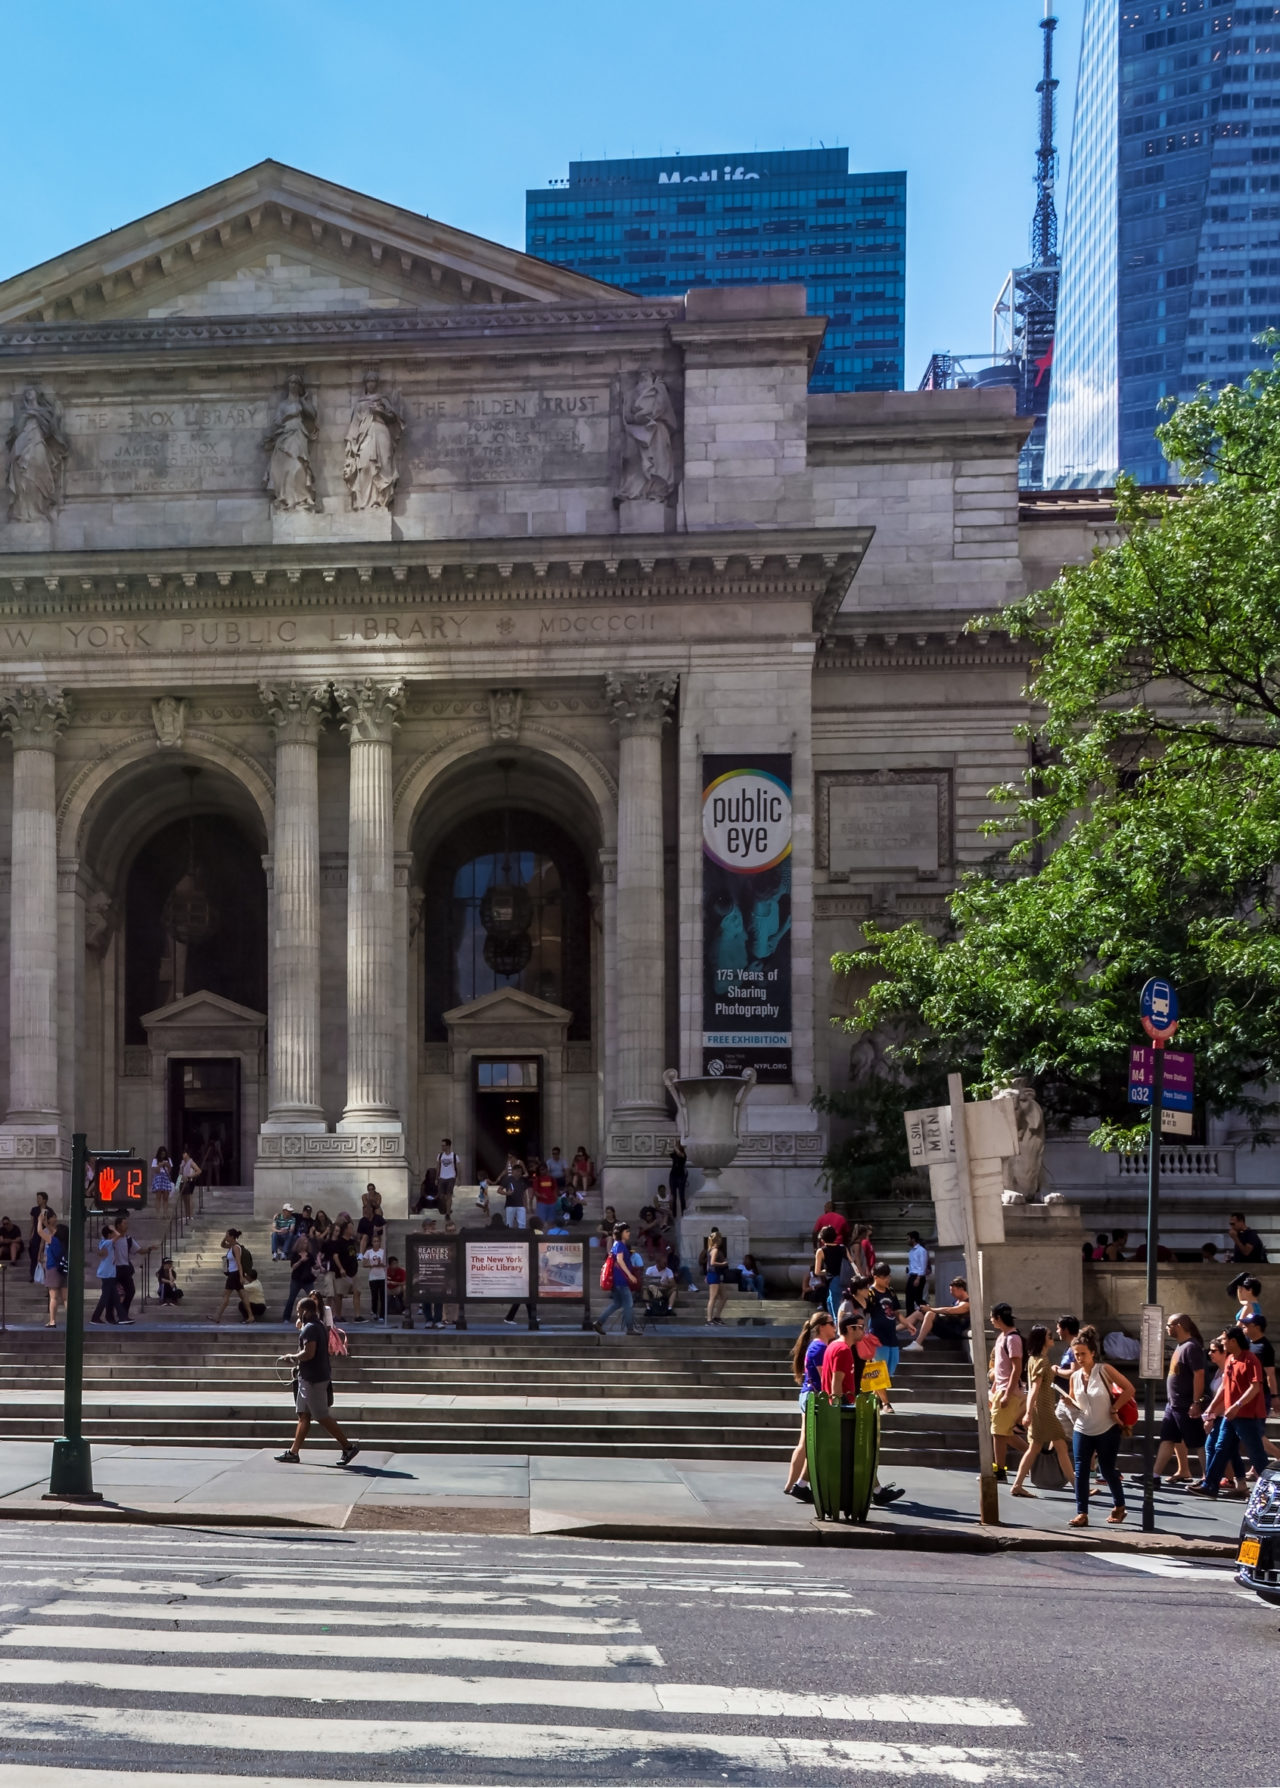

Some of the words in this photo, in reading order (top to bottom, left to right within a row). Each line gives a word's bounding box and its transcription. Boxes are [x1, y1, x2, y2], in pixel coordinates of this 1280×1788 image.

[412, 401, 446, 419] THE
[463, 399, 527, 417] TILDEN
[543, 396, 599, 412] TRUST
[75, 413, 108, 429] THE
[118, 411, 175, 428] LENOX
[185, 407, 258, 426] LIBRARY
[487, 432, 530, 444] JONES
[114, 446, 160, 457] JAMES
[171, 443, 217, 455] LENOX
[66, 624, 152, 650] YORK
[179, 621, 297, 645] PUBLIC
[328, 615, 469, 642] LIBRARY
[540, 614, 655, 634] MDCCCCII
[713, 788, 782, 828] public
[727, 827, 768, 858] eye
[717, 969, 734, 981] 175
[737, 969, 764, 981] Years
[767, 969, 778, 981] of
[727, 986, 766, 1000] Sharing
[715, 1003, 779, 1017] Photography
[707, 1036, 729, 1044] FREE
[732, 1036, 787, 1044] EXHIBITION
[1132, 1050, 1145, 1063] M1
[1131, 1068, 1145, 1082] M4
[1131, 1087, 1149, 1101] Q32
[127, 1169, 143, 1198] 12
[471, 1256, 485, 1264] The
[486, 1256, 504, 1264] New
[504, 1256, 523, 1264] York
[471, 1264, 494, 1272] Public
[496, 1264, 523, 1273] Library
